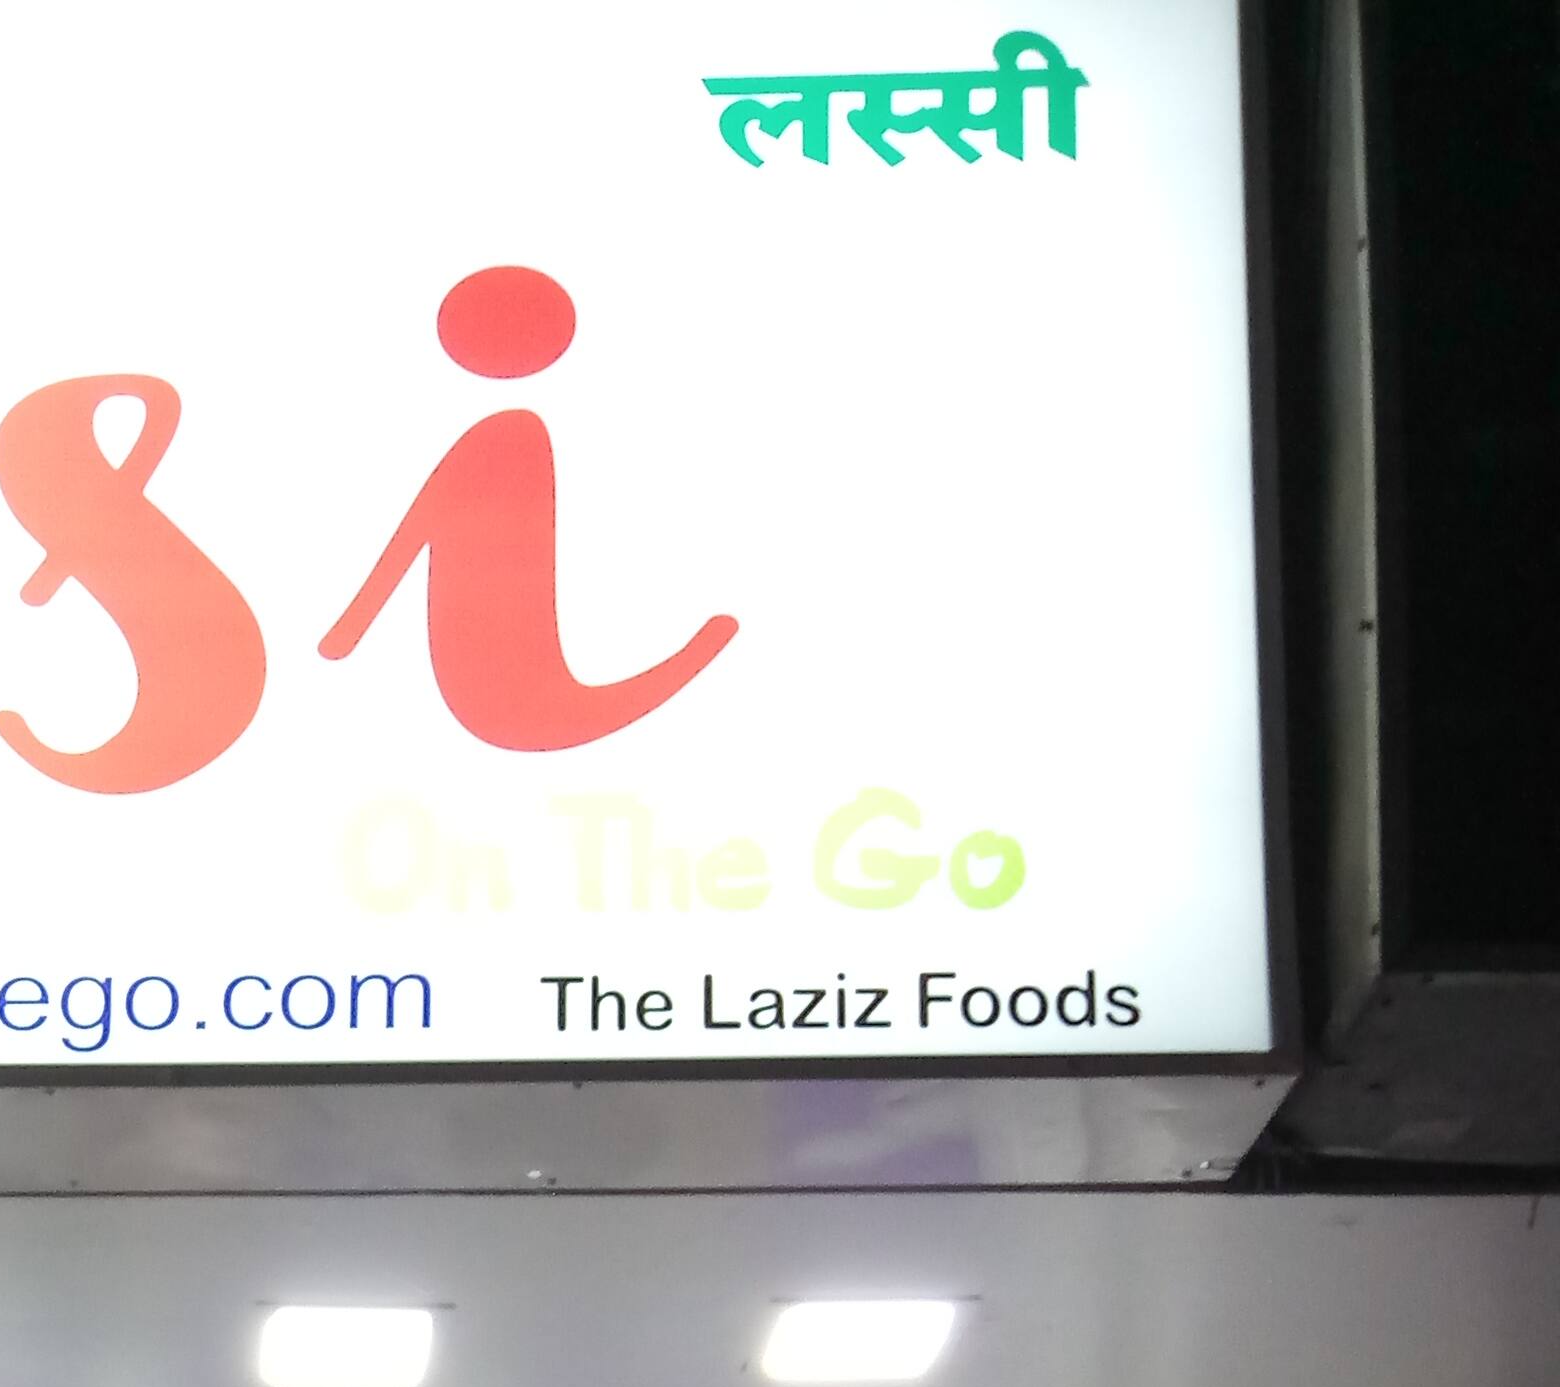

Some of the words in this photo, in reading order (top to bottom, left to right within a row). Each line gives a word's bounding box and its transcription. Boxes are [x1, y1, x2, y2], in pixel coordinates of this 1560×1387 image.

[702, 29, 1090, 168] लस्सी
[340, 796, 514, 914] On
[546, 792, 773, 912] The
[812, 786, 1028, 912] Go
[541, 974, 672, 1031] The
[704, 972, 891, 1030] Laziz
[920, 969, 1141, 1028] Foods
